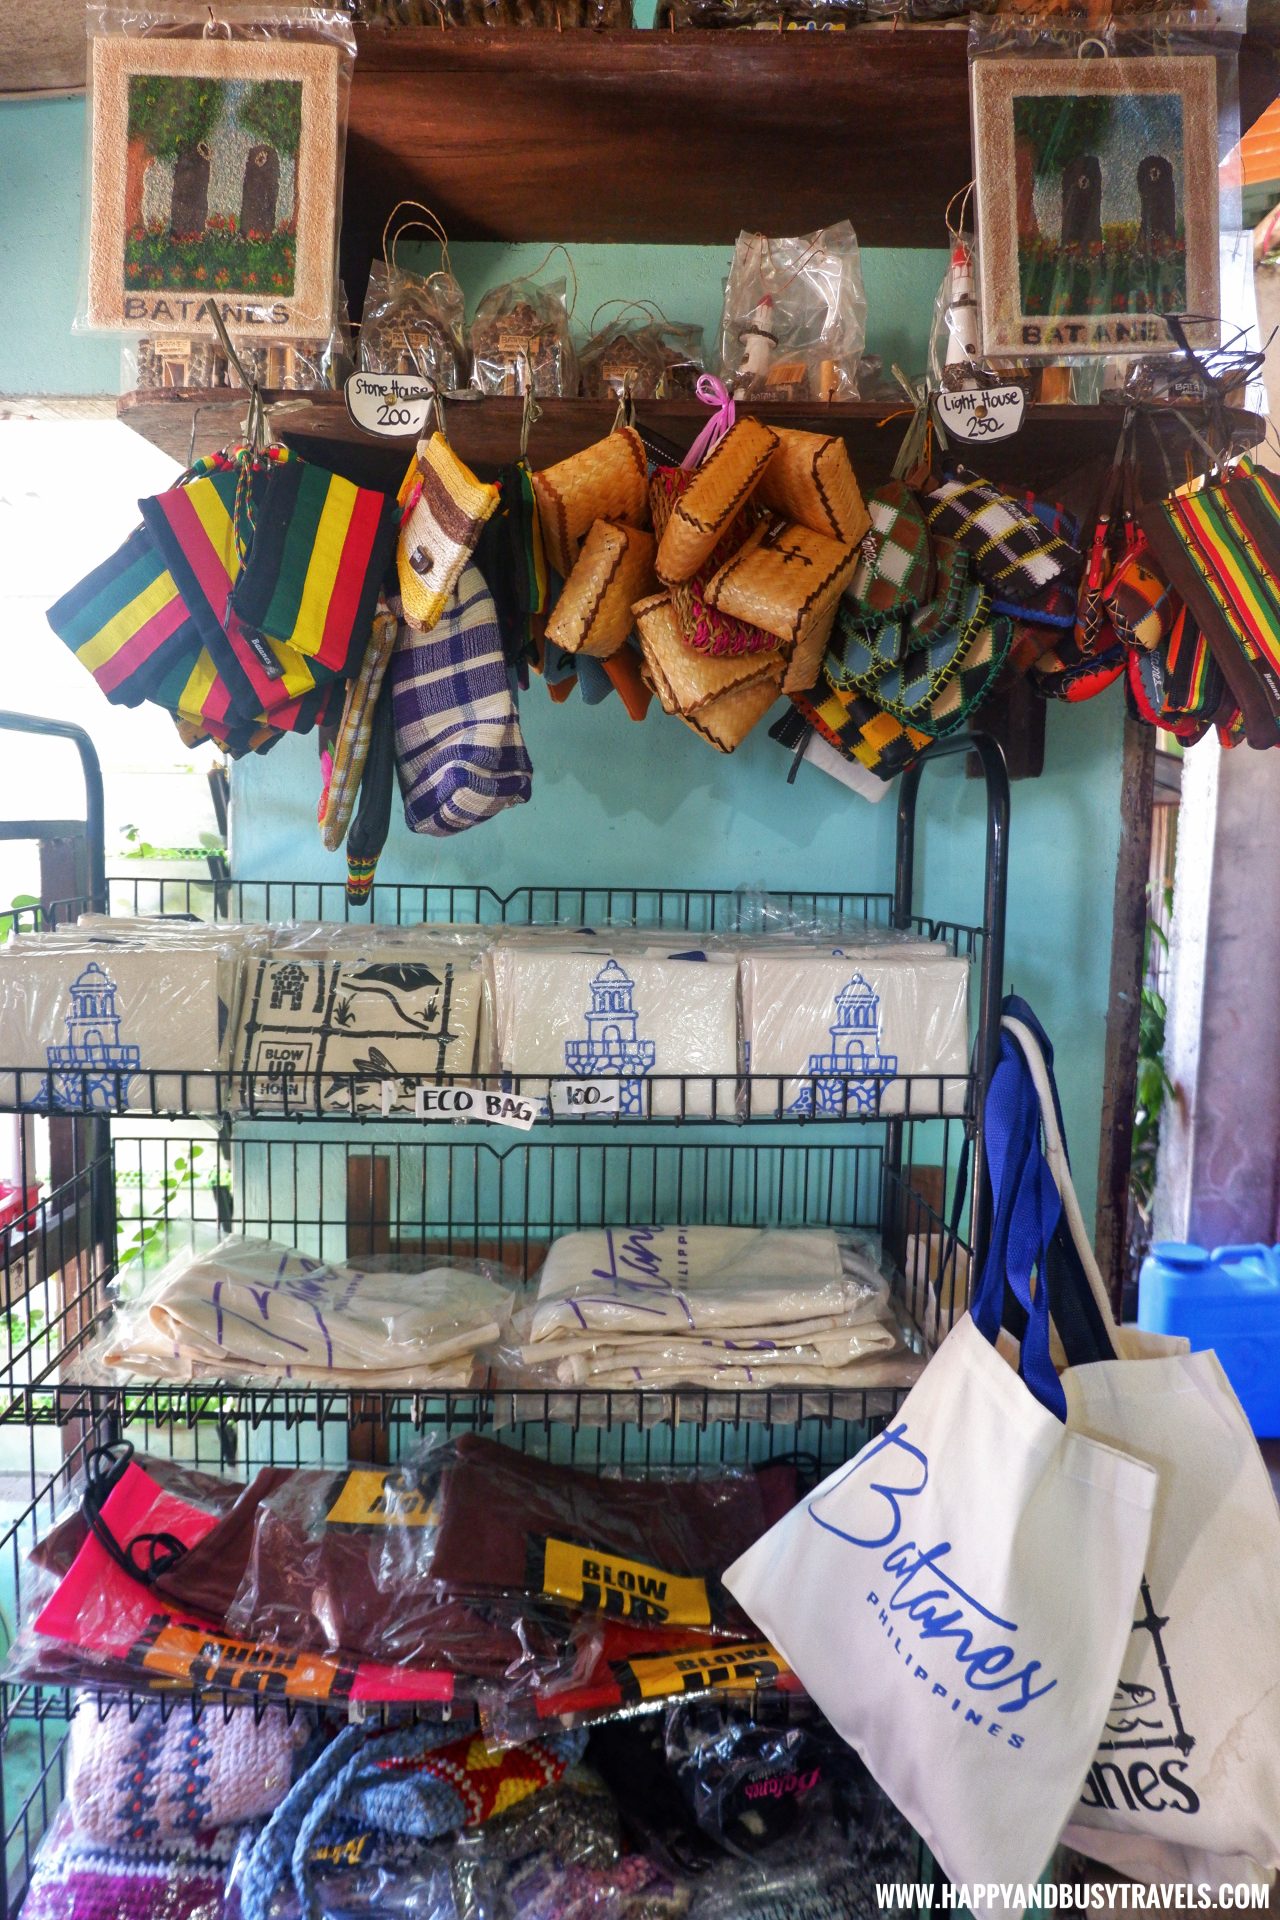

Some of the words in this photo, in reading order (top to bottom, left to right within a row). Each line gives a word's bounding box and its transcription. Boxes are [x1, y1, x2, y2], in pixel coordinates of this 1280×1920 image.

[123, 297, 290, 325] BATANES
[1022, 322, 1178, 346] BATANE
[355, 379, 388, 397] Stone
[943, 393, 977, 414] Light
[981, 391, 1020, 410] House
[250, 638, 272, 665] Batanes
[265, 1049, 304, 1060] BLOW
[423, 1089, 474, 1112] ECO
[485, 1095, 532, 1122] BAG
[581, 1558, 667, 1602] BLOW
[808, 1423, 1057, 1713] Batanes
[867, 1591, 1025, 1749] PHILIPPINES
[1080, 1759, 1200, 1814] anes
